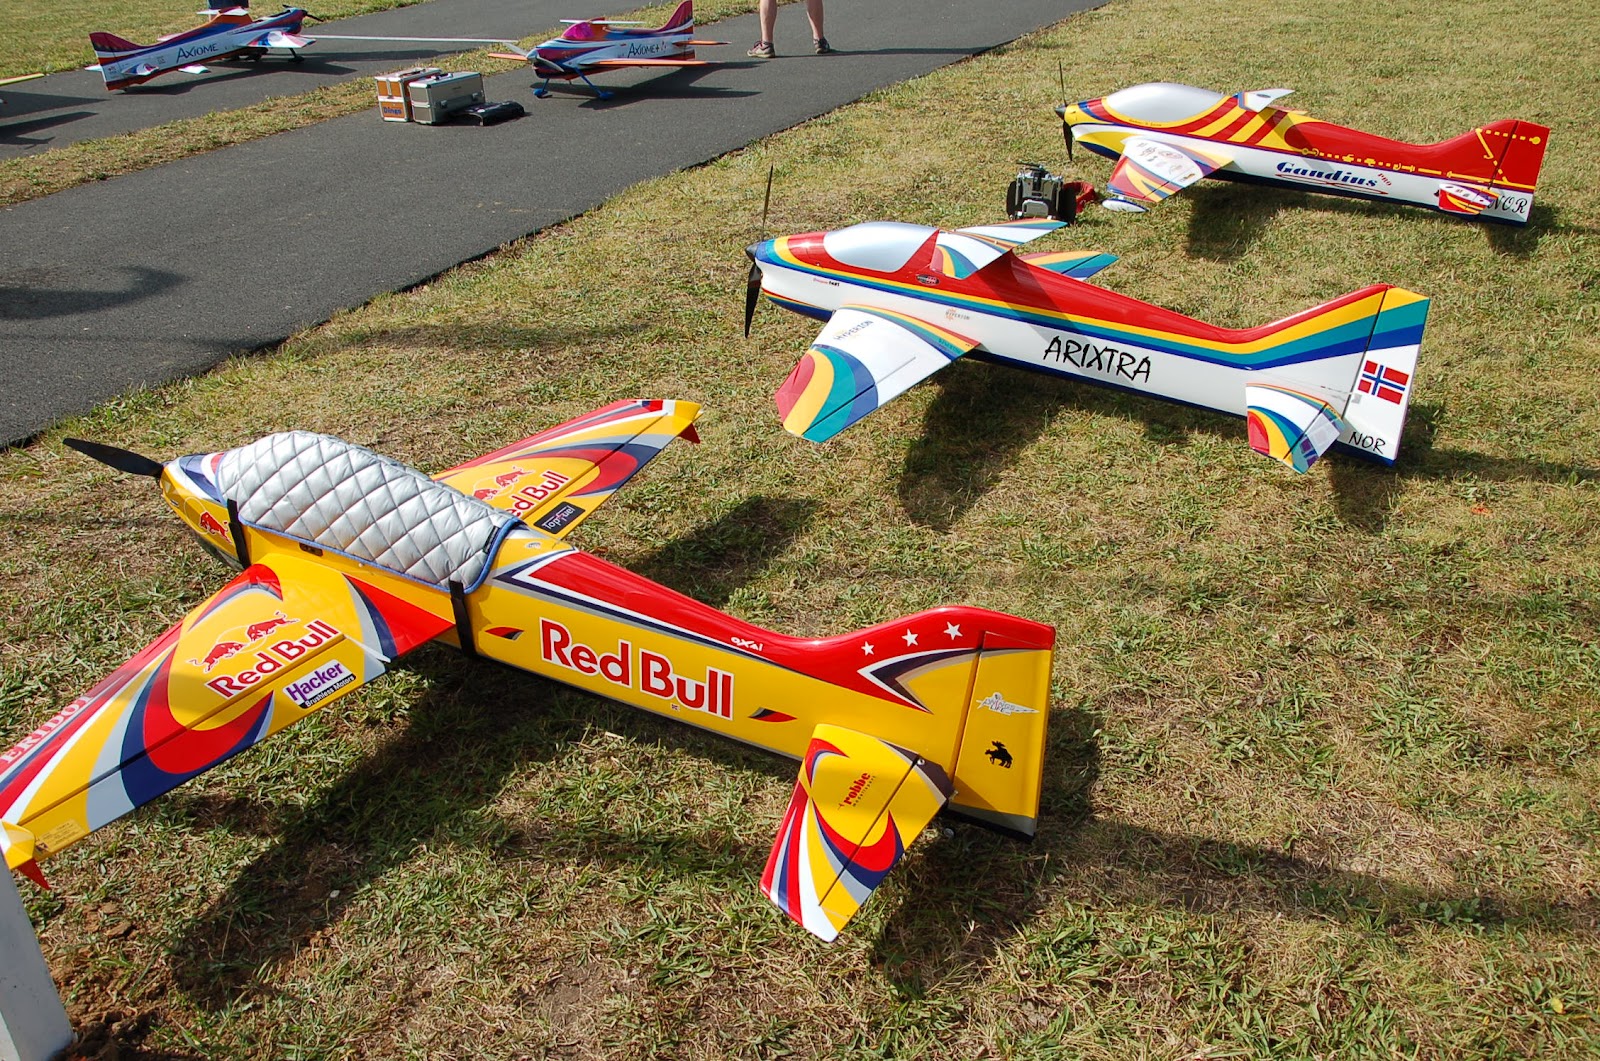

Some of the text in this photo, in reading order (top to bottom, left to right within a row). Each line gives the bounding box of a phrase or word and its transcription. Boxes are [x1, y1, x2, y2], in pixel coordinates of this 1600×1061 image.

[1487, 194, 1528, 214] NOR
[1043, 335, 1150, 383] ARIXTRA
[1348, 431, 1386, 455] NOR
[520, 470, 570, 501] Bull
[206, 619, 341, 699] Red Bull
[540, 618, 733, 720] Red Bull
[286, 662, 344, 702] Hacker
[304, 674, 355, 708] Brushless Motors
[843, 772, 871, 805] robbe
